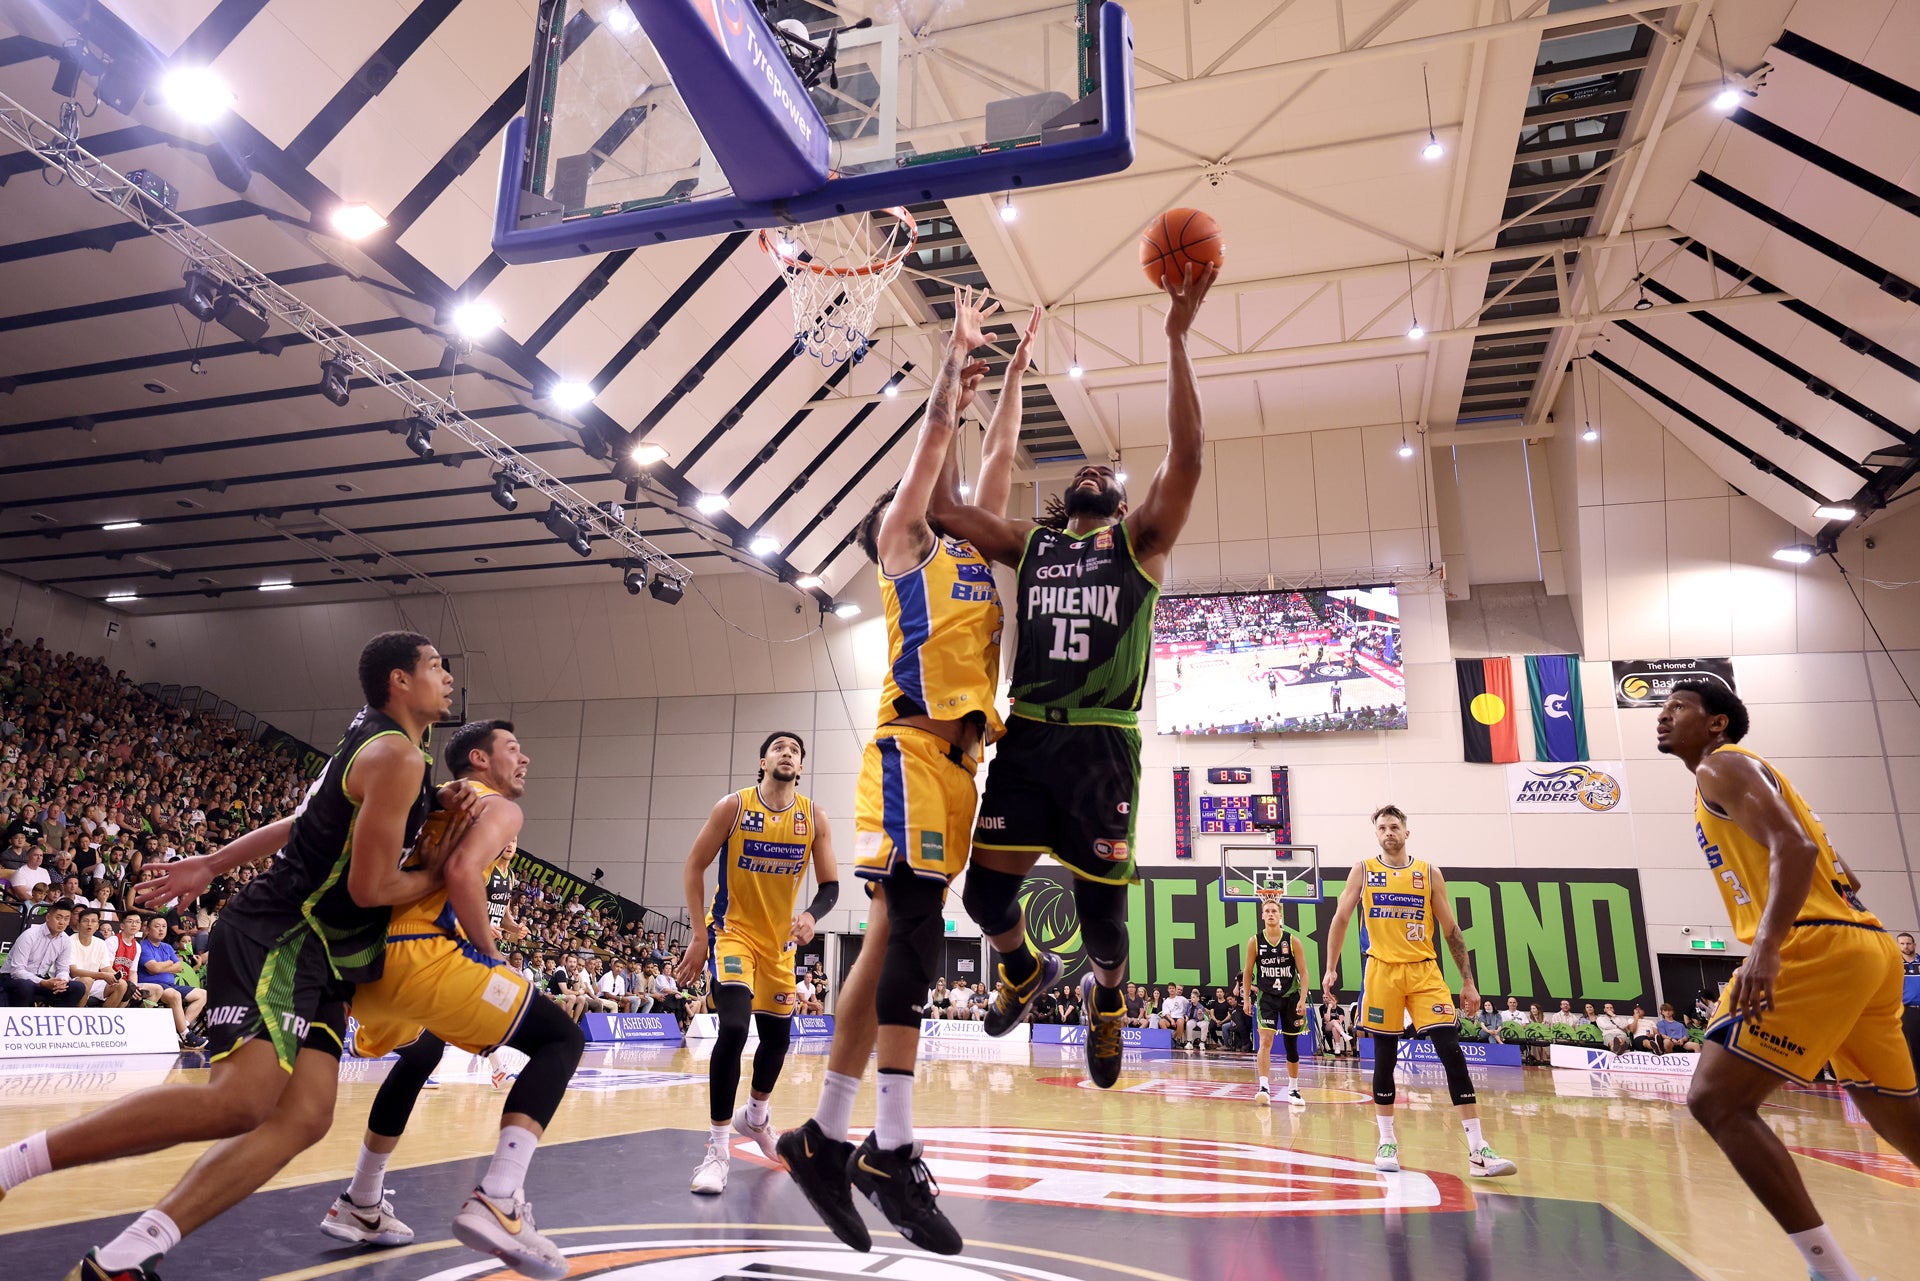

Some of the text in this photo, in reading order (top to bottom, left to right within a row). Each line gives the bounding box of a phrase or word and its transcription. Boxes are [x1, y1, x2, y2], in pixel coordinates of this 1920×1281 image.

[745, 23, 812, 142] Tyrepower
[1036, 563, 1076, 580] GOAT
[107, 622, 119, 637] F
[1049, 617, 1090, 662] 15
[1522, 780, 1581, 792] KNOX
[1516, 793, 1578, 802] RAIDERS
[1267, 804, 1277, 820] 8
[978, 816, 1006, 830] ADIE
[763, 843, 804, 855] Genevieve
[1720, 869, 1751, 906] 3
[1388, 894, 1424, 904] Genevieve
[1369, 907, 1425, 921] BULLETS
[1406, 922, 1425, 941] 20
[1272, 978, 1282, 991] 4
[4, 1015, 125, 1037] ASHFORDS
[622, 1017, 662, 1030] ASHFORDS
[944, 1022, 985, 1033] ASHFO
[24, 1042, 47, 1050] YOUR
[49, 1041, 90, 1049] FINANCIAL
[91, 1040, 127, 1048] FREEDOM
[1749, 1024, 1806, 1056] Genius
[1612, 1054, 1690, 1067] ASHFORDS
